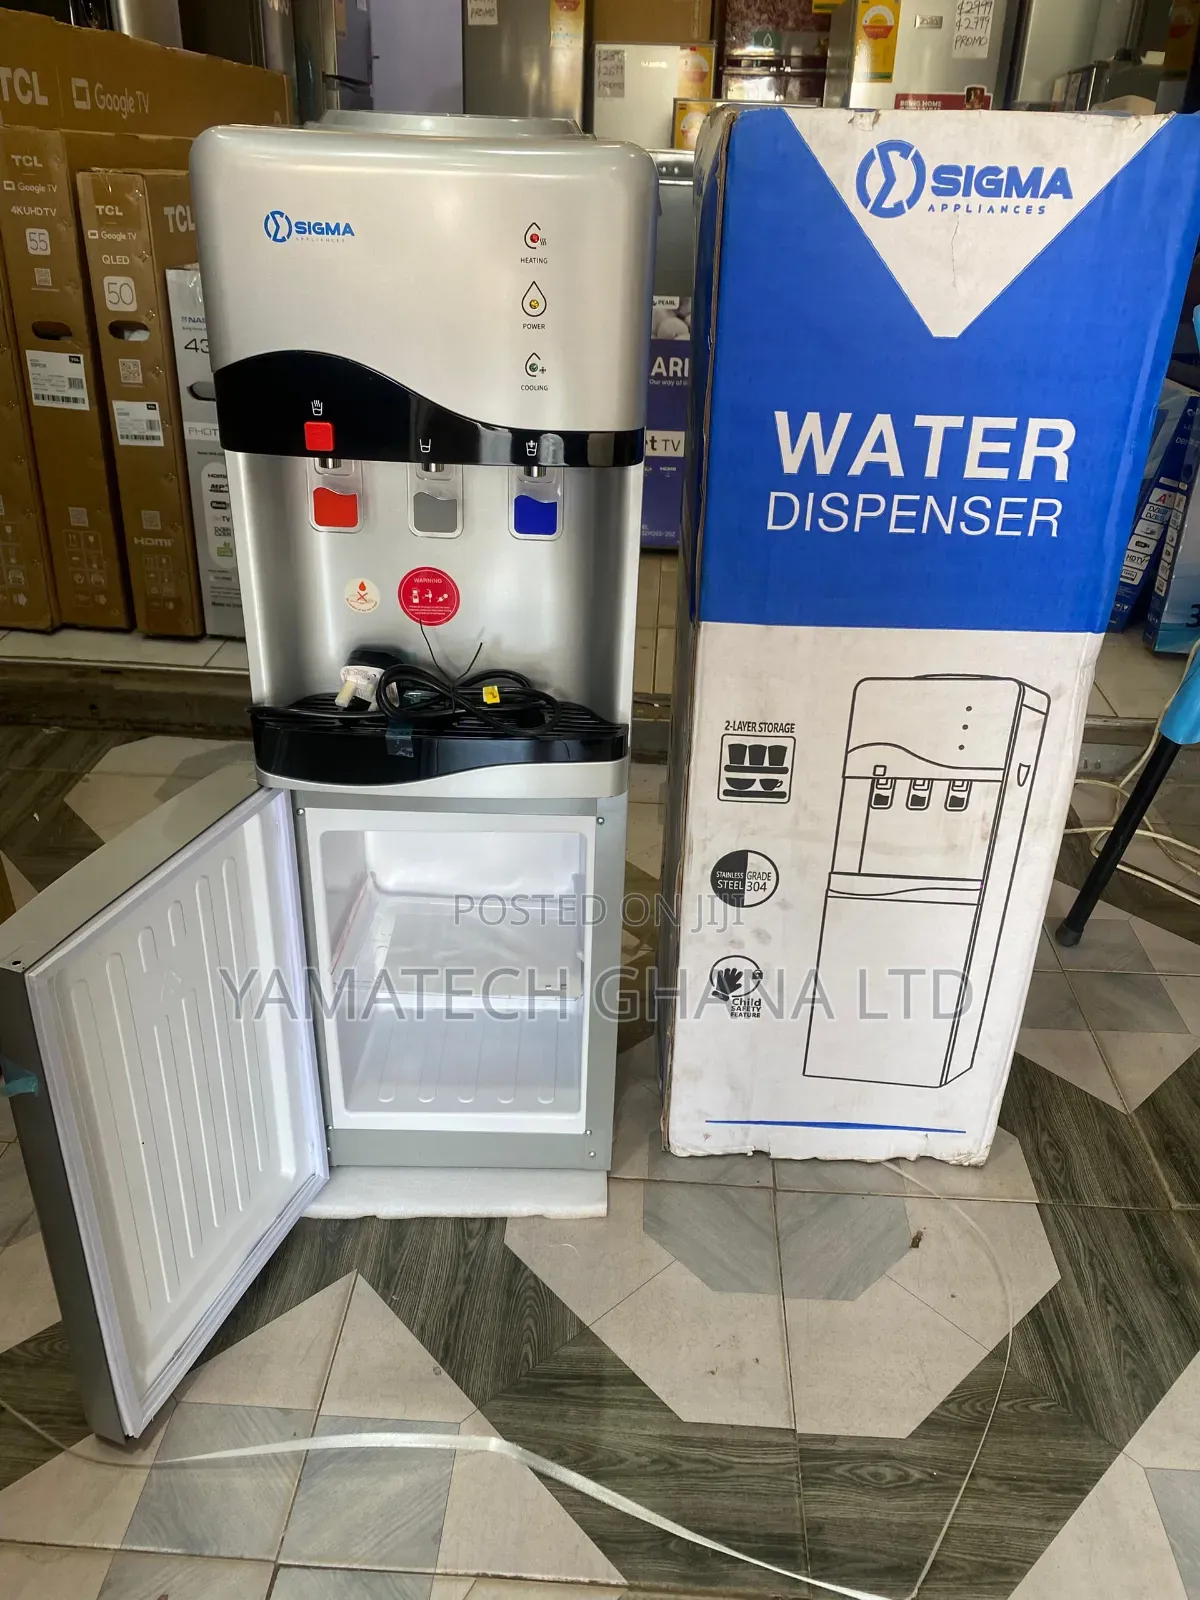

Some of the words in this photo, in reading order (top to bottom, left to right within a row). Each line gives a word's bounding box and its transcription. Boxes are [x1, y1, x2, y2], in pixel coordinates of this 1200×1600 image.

[954, 35, 988, 50] PROMO
[0, 66, 49, 106] TCL
[94, 83, 135, 119] Google
[136, 91, 149, 114] TV
[11, 154, 43, 168] TCL
[18, 181, 46, 193] Google
[47, 184, 58, 193] TV
[930, 164, 1074, 200] SIGMA
[95, 205, 123, 216] TCL
[927, 203, 1046, 215] APPLIANCES
[163, 204, 196, 233] TCL
[294, 221, 355, 236] SIGMA
[28, 231, 49, 251] 55
[101, 231, 126, 241] Google
[127, 232, 137, 240] TV
[102, 254, 130, 265] QLED
[520, 257, 548, 265] HEATING
[107, 282, 134, 306] 50
[662, 439, 681, 452] TV
[774, 410, 1077, 482] WATER
[766, 491, 1063, 537] DISPENSER
[133, 536, 173, 547] HDMI
[1126, 552, 1146, 565] HDTV
[724, 720, 757, 732] 2-LAYER
[758, 722, 796, 733] STORAGE
[716, 871, 744, 879] STAINLESS
[747, 871, 772, 881] GRADE
[717, 880, 744, 890] STEEL
[746, 881, 767, 892] 304
[732, 997, 762, 1006] Child
